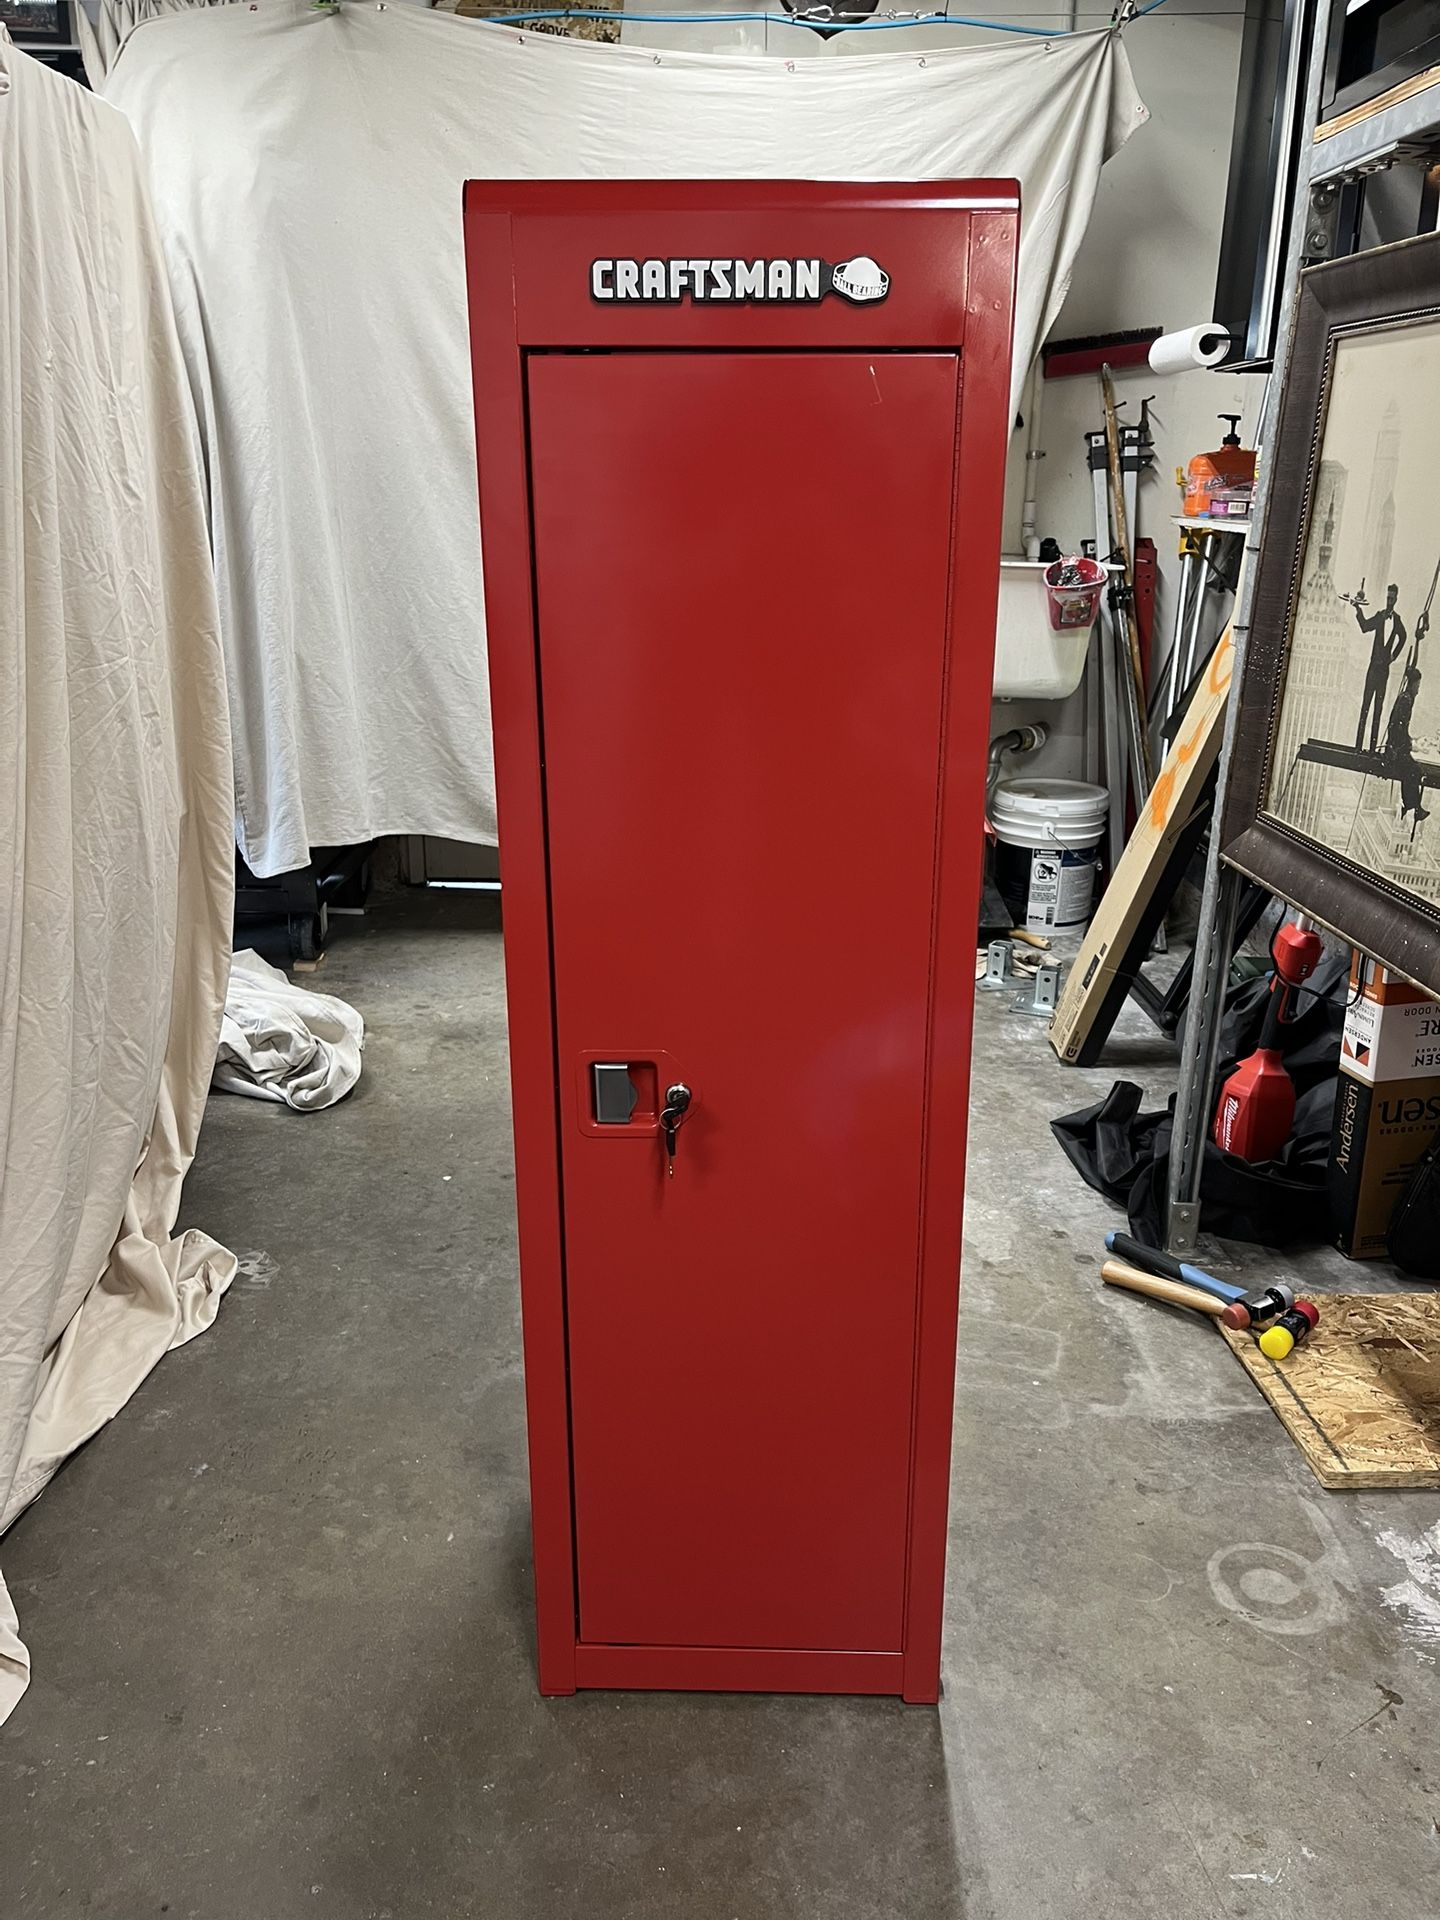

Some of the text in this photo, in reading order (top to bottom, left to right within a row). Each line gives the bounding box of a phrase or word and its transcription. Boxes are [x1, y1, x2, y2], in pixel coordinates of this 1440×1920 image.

[592, 259, 820, 299] CRAFTSMAN
[1404, 1006, 1431, 1017] DOOR
[1336, 1084, 1359, 1174] Andersen
